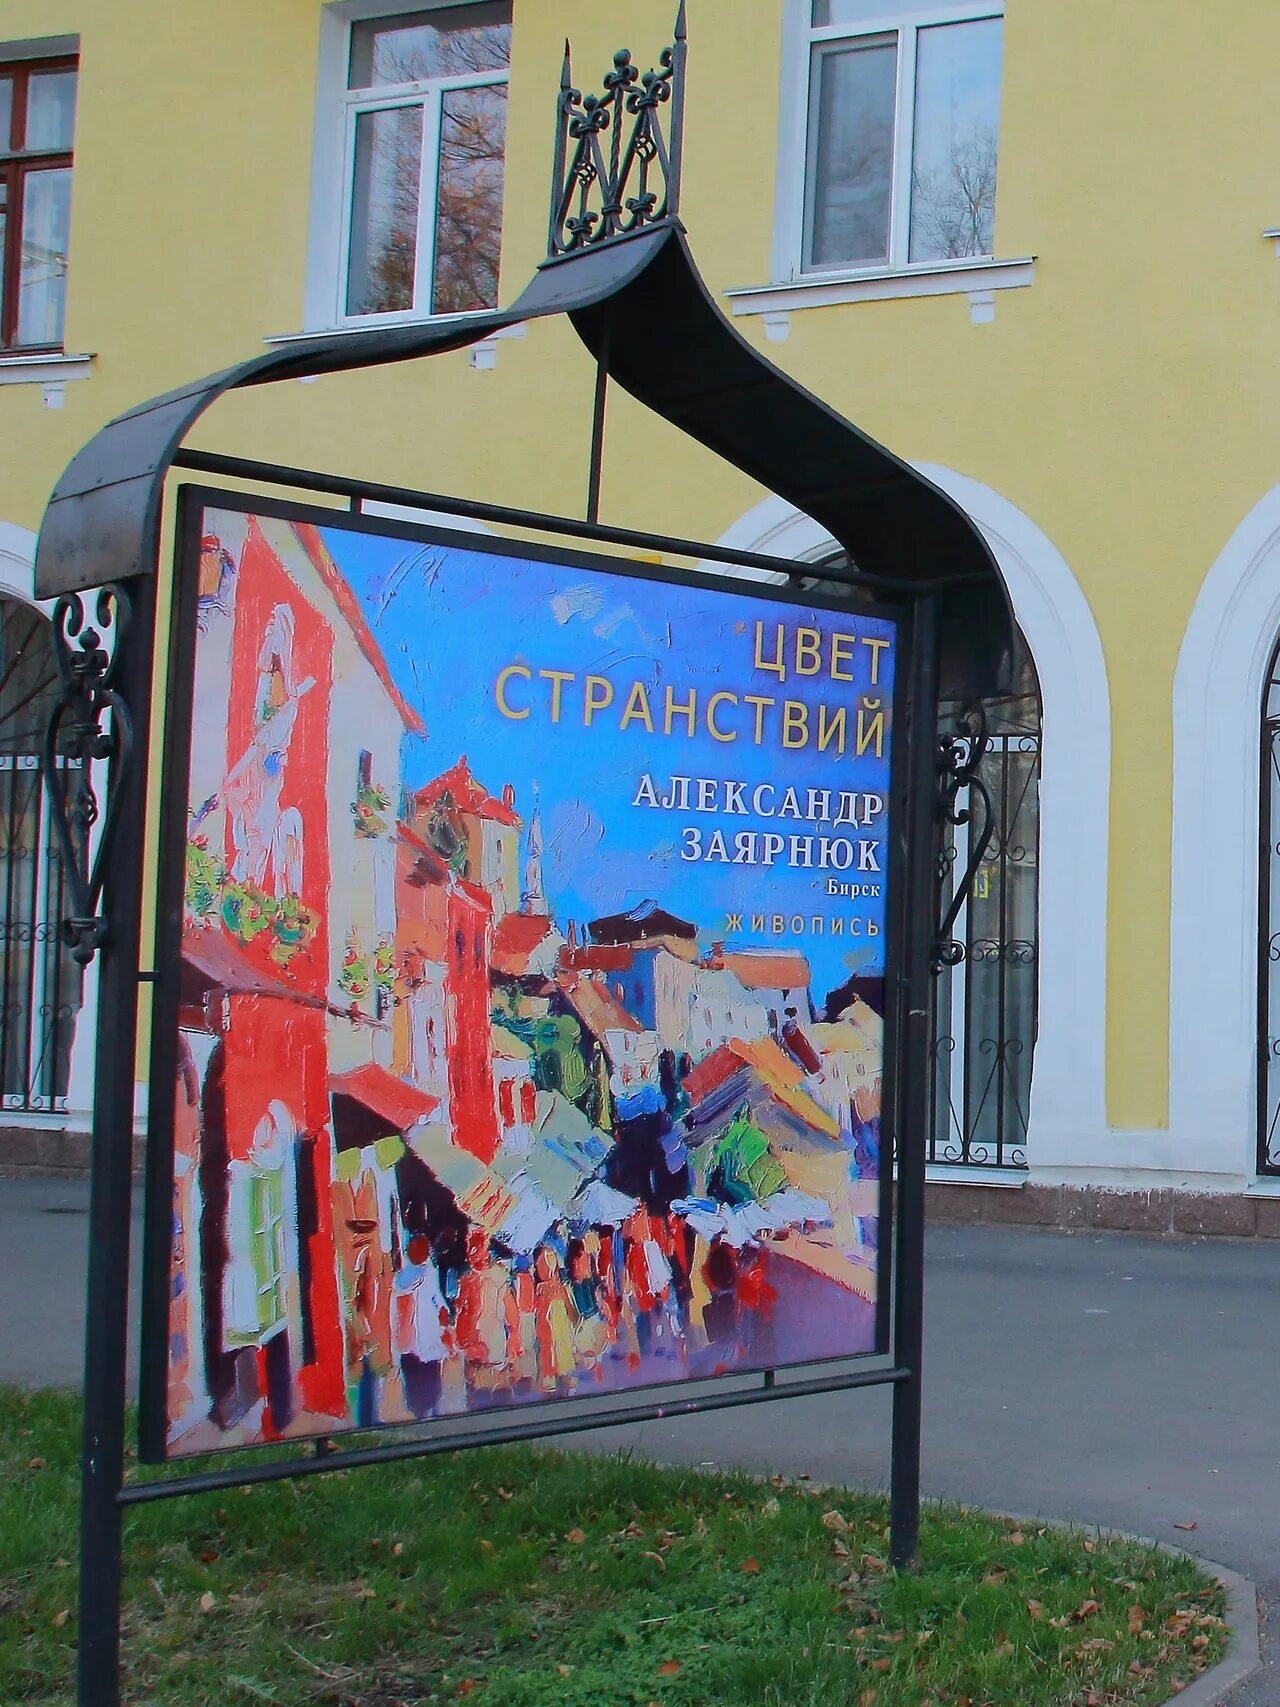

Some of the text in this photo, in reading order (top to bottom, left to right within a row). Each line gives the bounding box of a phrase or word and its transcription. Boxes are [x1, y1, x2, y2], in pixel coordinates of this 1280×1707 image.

[754, 620, 891, 685] ЦВЕТ
[495, 664, 884, 758] СТРАНСТВИЙ
[632, 773, 883, 830] АЛЕКСАНДР
[680, 827, 881, 871] ЗАЯРНЮК
[827, 878, 881, 898] Бирск
